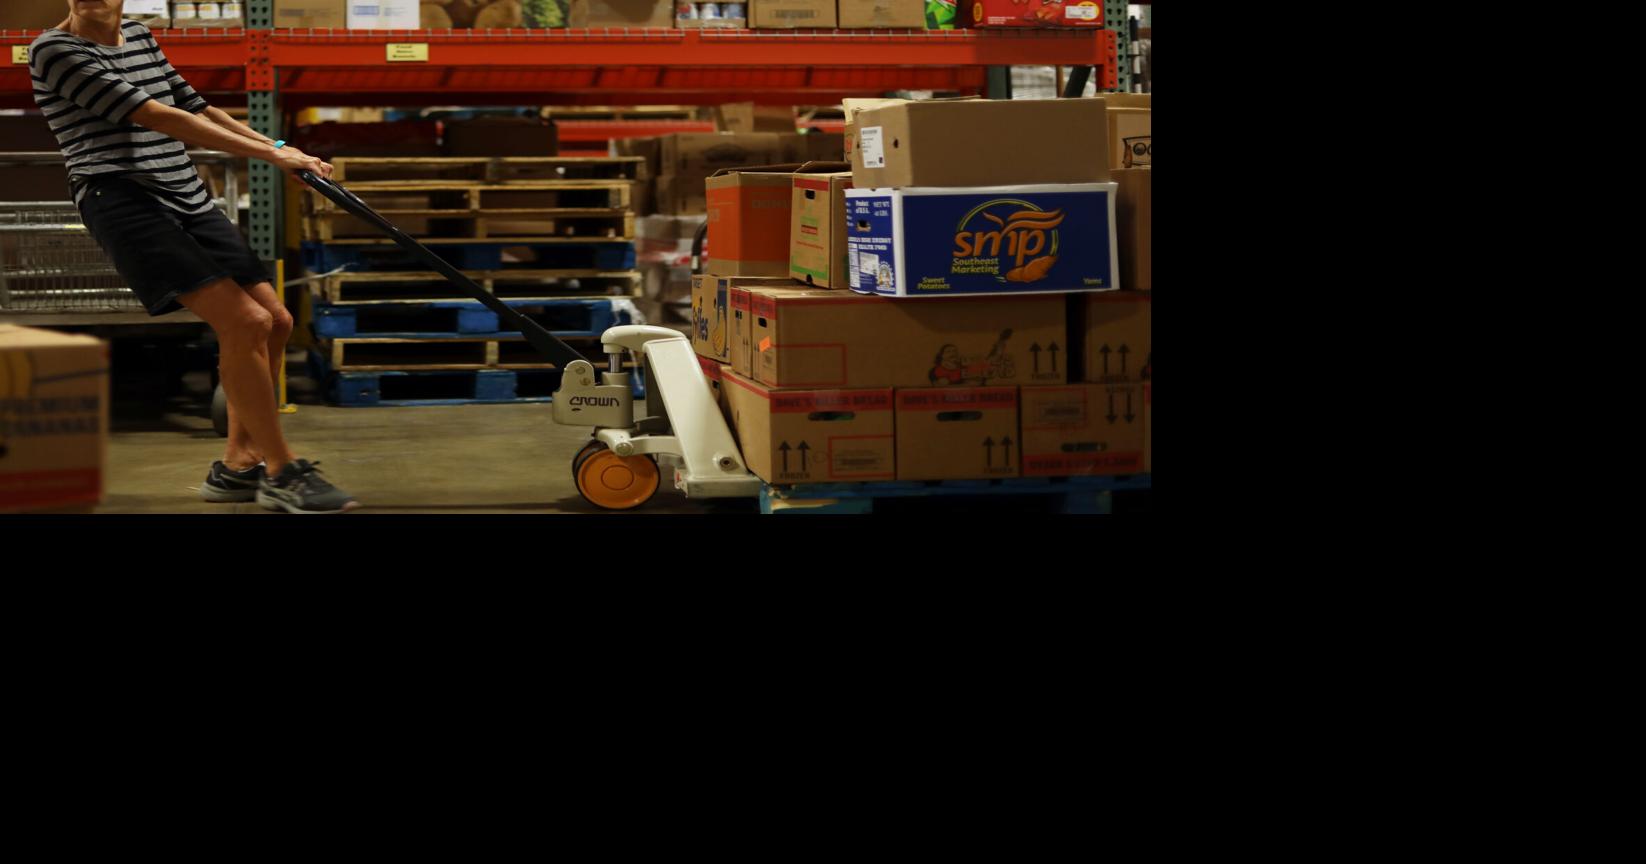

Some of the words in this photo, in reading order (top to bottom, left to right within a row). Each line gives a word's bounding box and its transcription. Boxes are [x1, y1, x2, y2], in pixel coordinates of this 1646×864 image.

[952, 229, 1046, 267] smp
[952, 257, 999, 267] Southeast
[951, 265, 1000, 275] Marketing
[922, 276, 945, 284] Sweet
[917, 282, 950, 291] Potatoes
